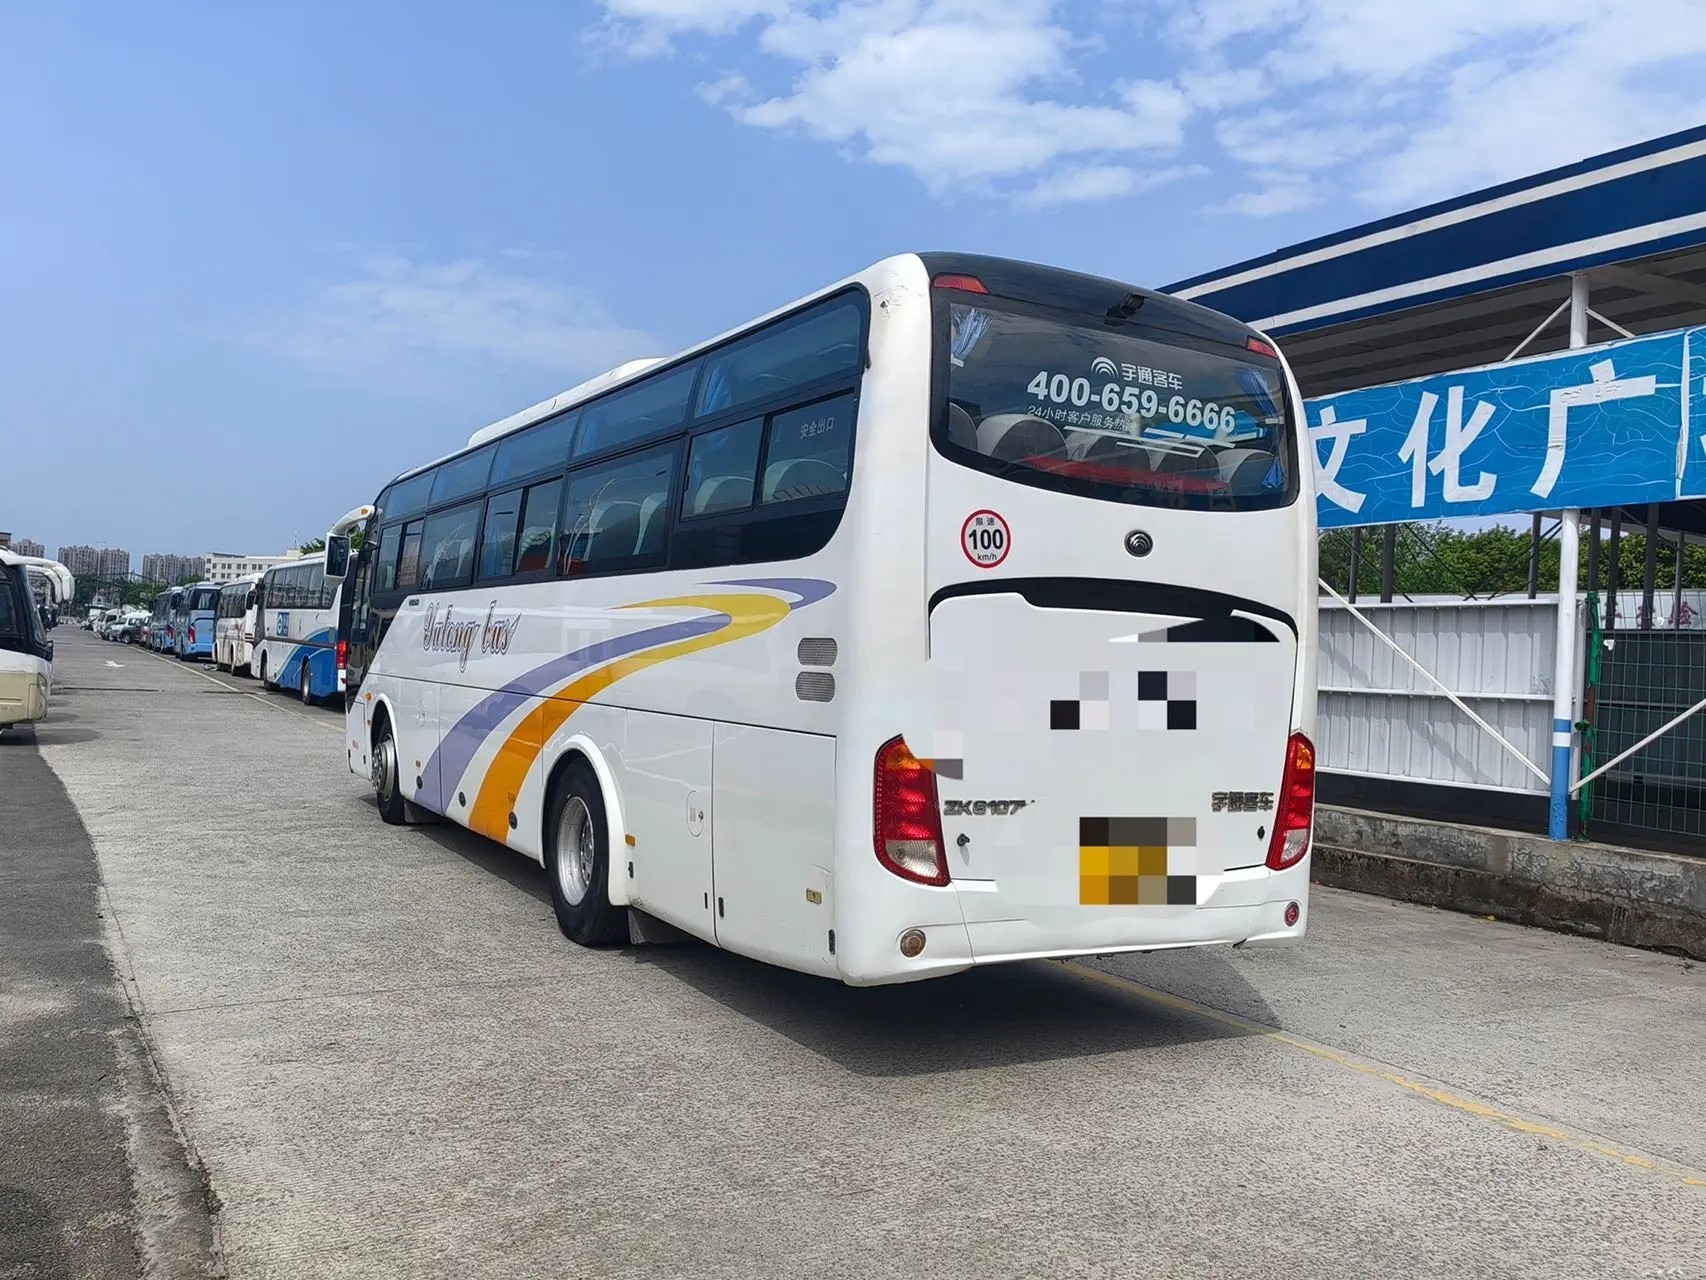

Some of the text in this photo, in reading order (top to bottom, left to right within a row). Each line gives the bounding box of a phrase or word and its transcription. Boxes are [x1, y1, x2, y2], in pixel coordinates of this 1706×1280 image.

[1121, 363, 1183, 391] 宇通客车
[1027, 370, 1236, 435] 400-659-6666
[800, 416, 835, 440] 安全出口
[1307, 358, 1706, 514] 文化广
[968, 528, 1004, 550] 100
[977, 552, 998, 561] km/h
